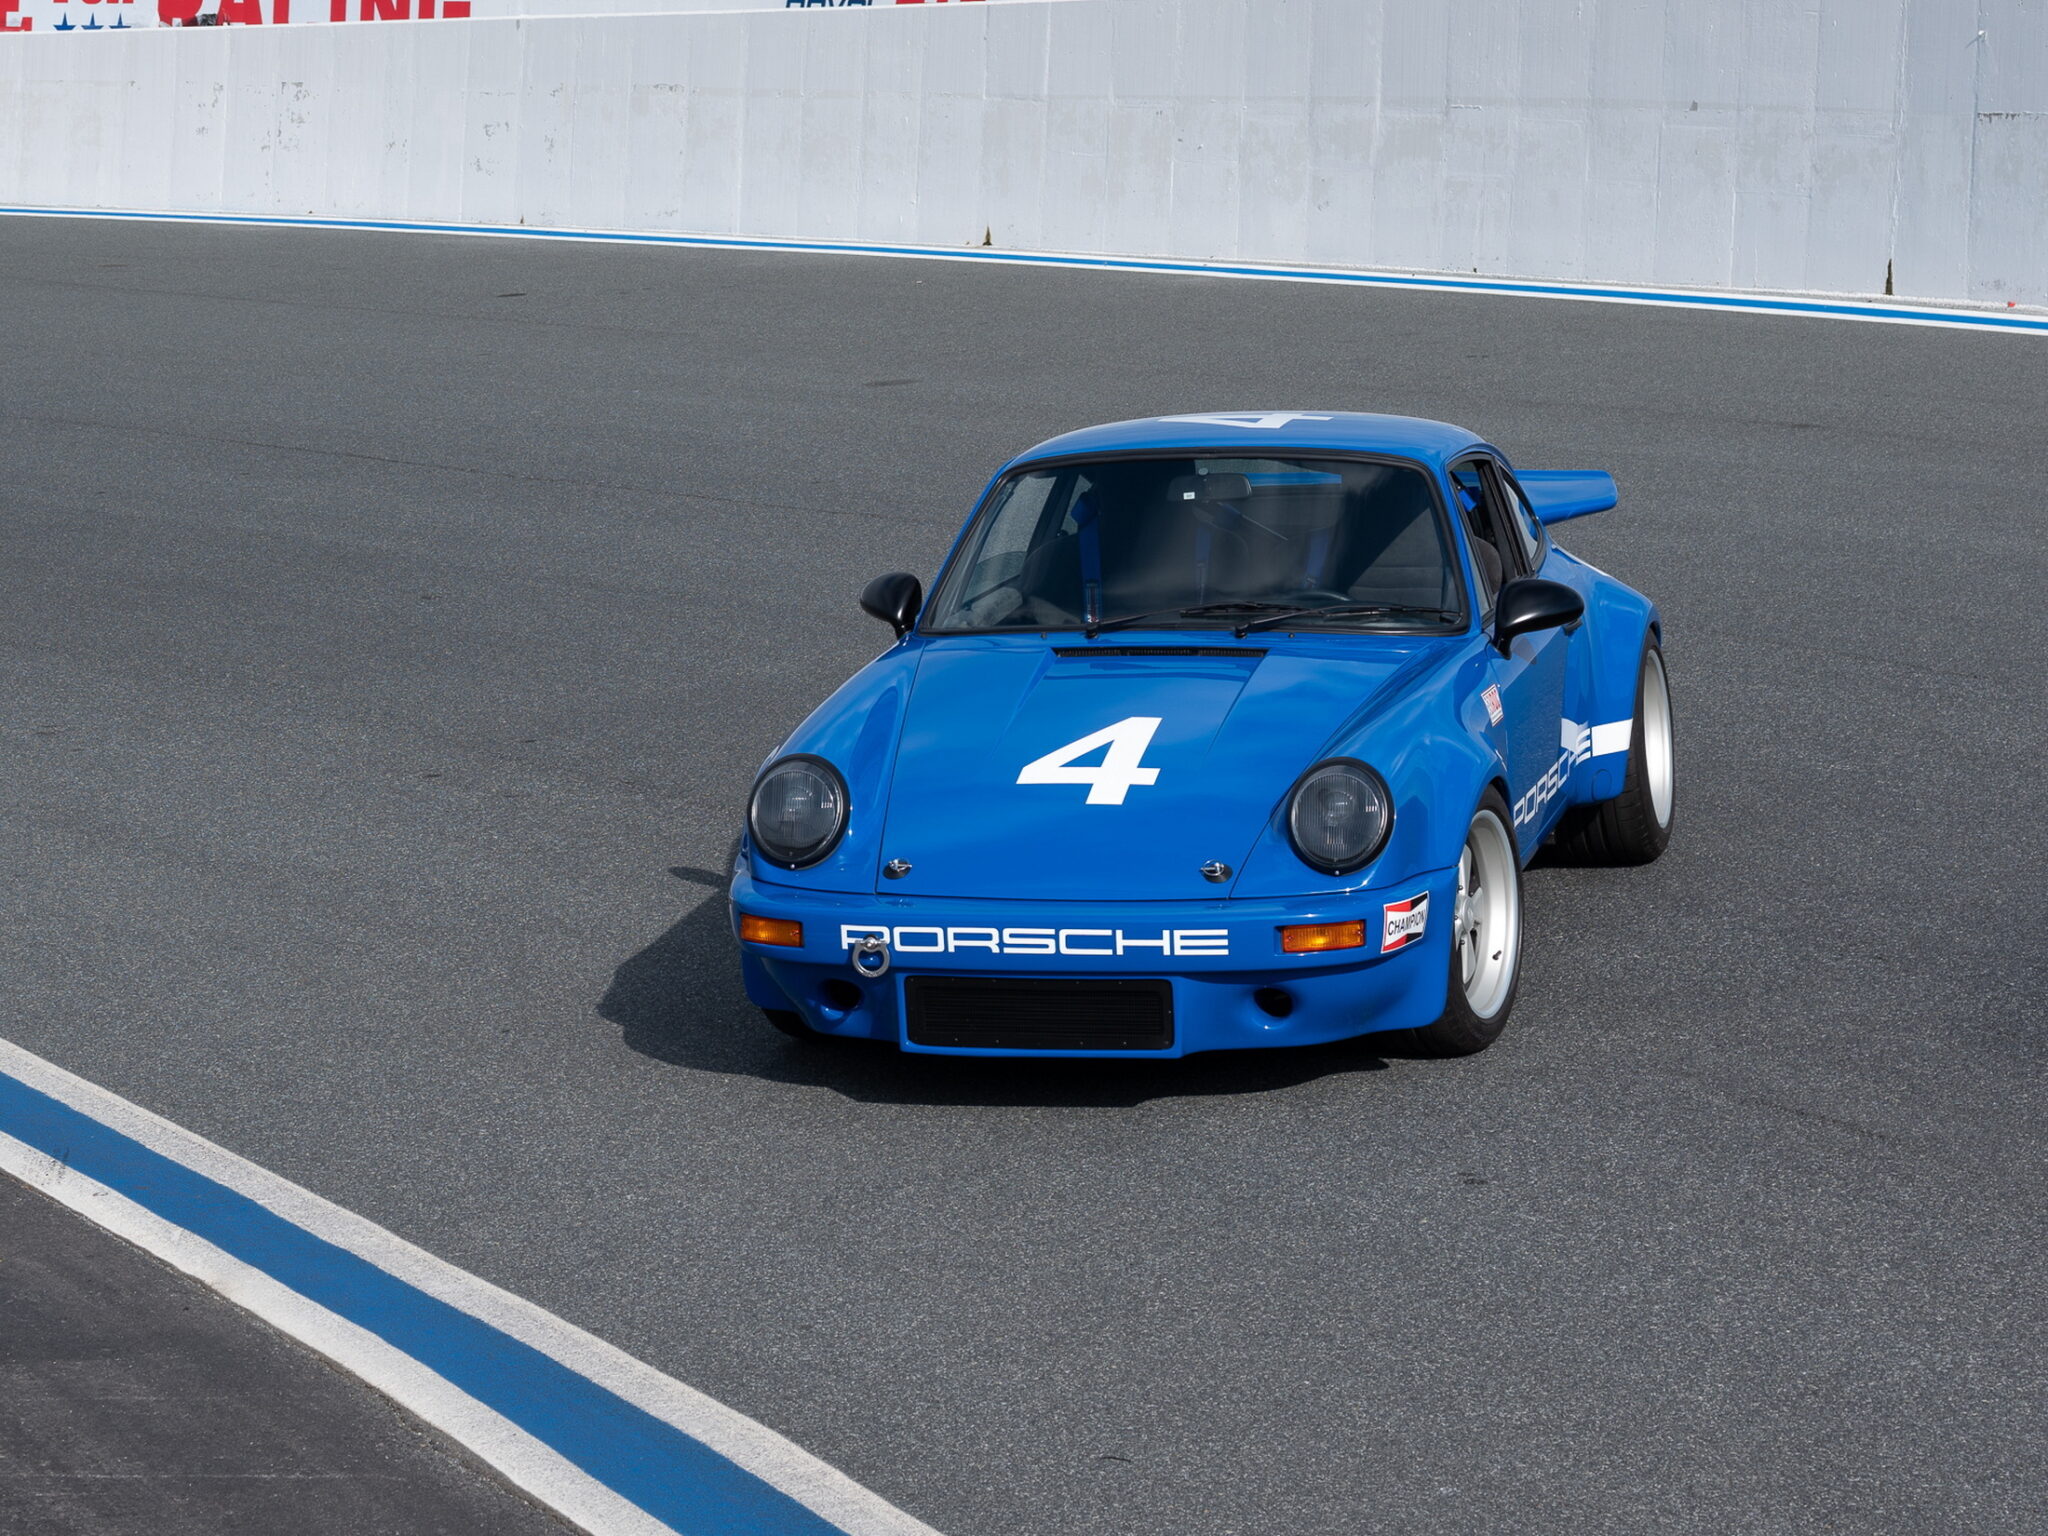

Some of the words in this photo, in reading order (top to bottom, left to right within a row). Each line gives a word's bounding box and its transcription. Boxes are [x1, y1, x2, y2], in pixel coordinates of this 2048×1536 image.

[1016, 716, 1163, 805] 4
[1388, 909, 1425, 936] CHAMPION
[840, 924, 1229, 956] PORSCHE
